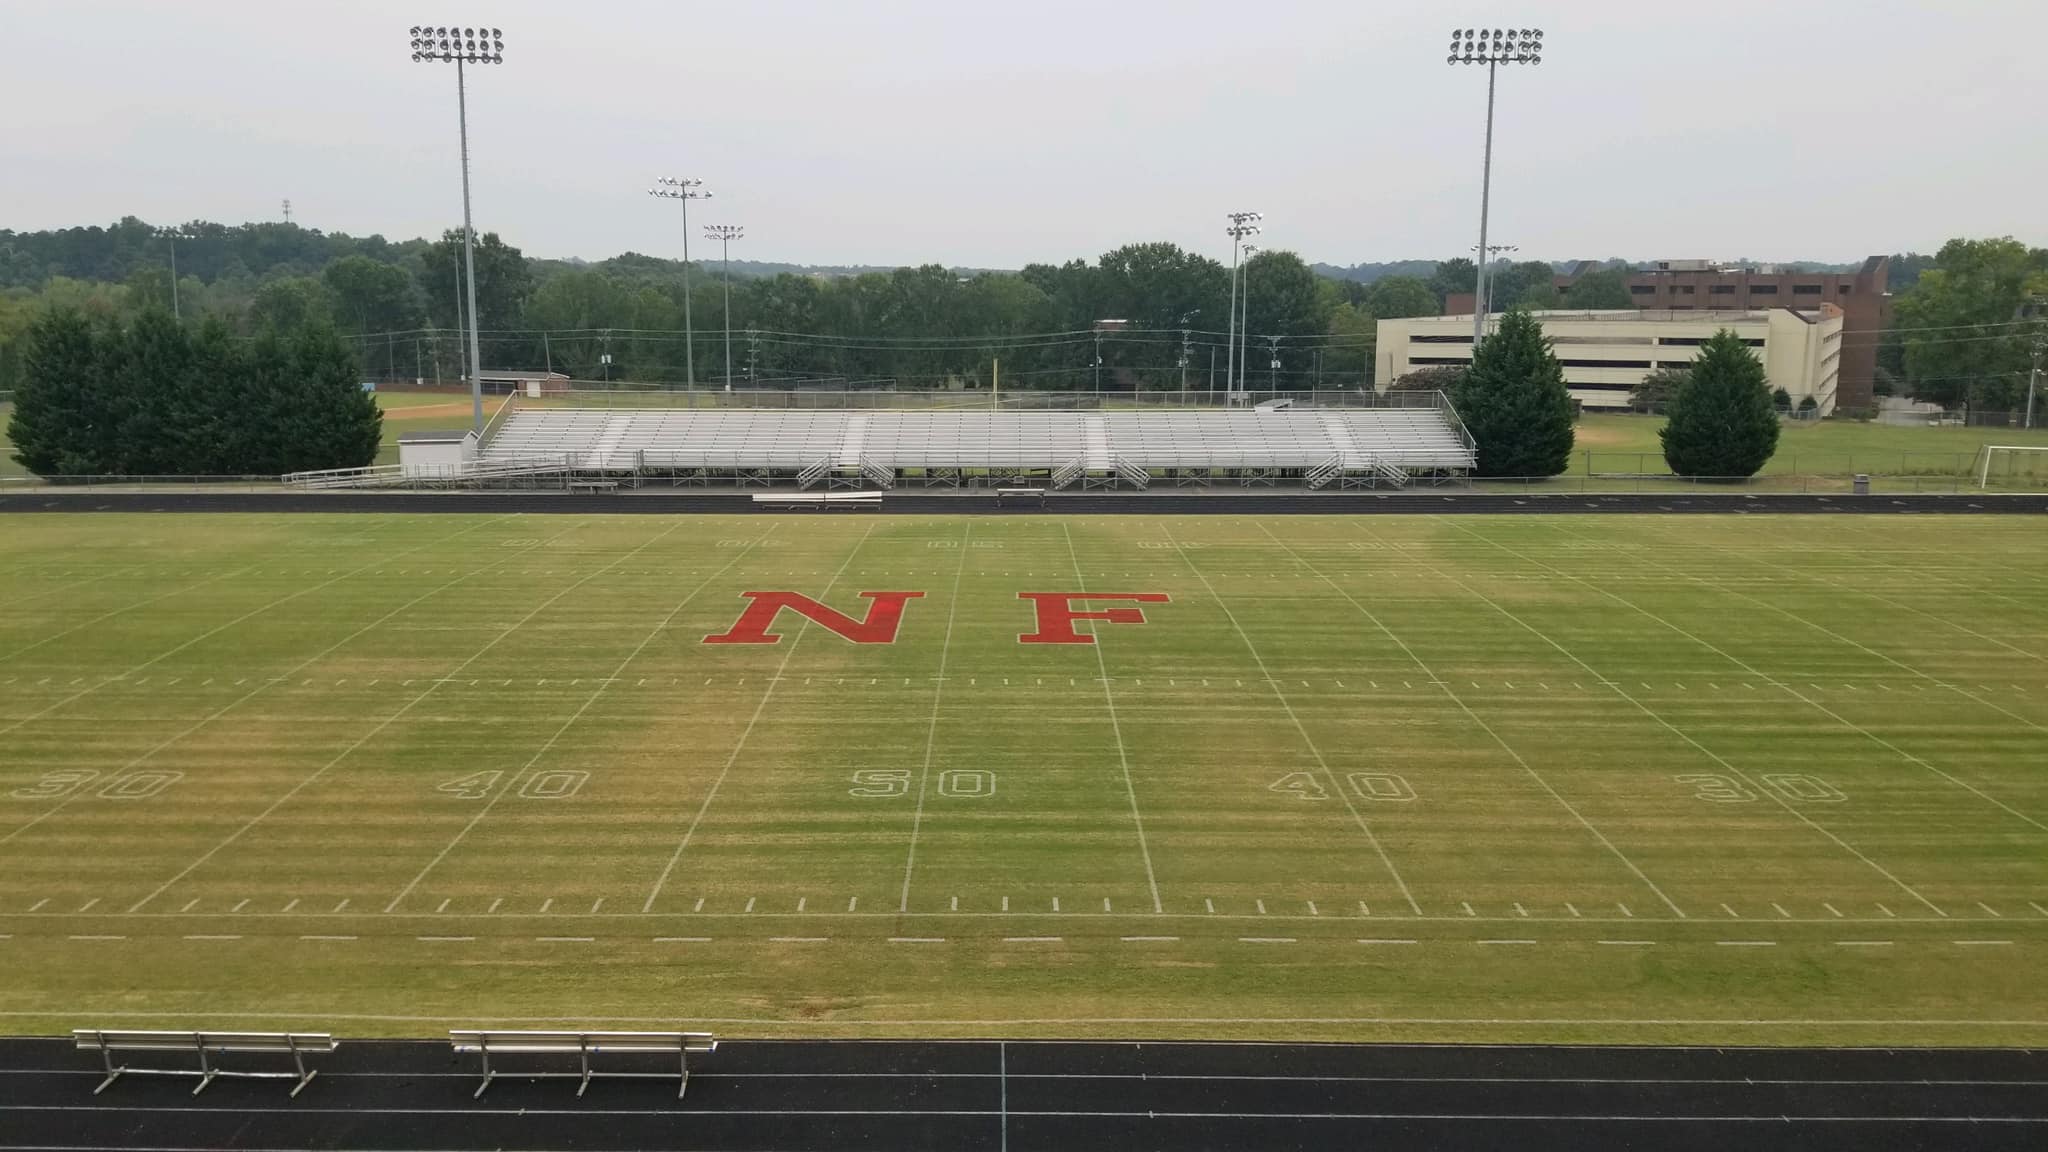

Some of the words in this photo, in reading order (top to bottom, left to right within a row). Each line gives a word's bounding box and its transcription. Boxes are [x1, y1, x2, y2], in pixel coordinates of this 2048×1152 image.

[701, 591, 927, 644] N
[1016, 592, 1173, 644] F
[437, 770, 591, 799] 40
[848, 769, 997, 798] 50
[1268, 772, 1419, 801] 40
